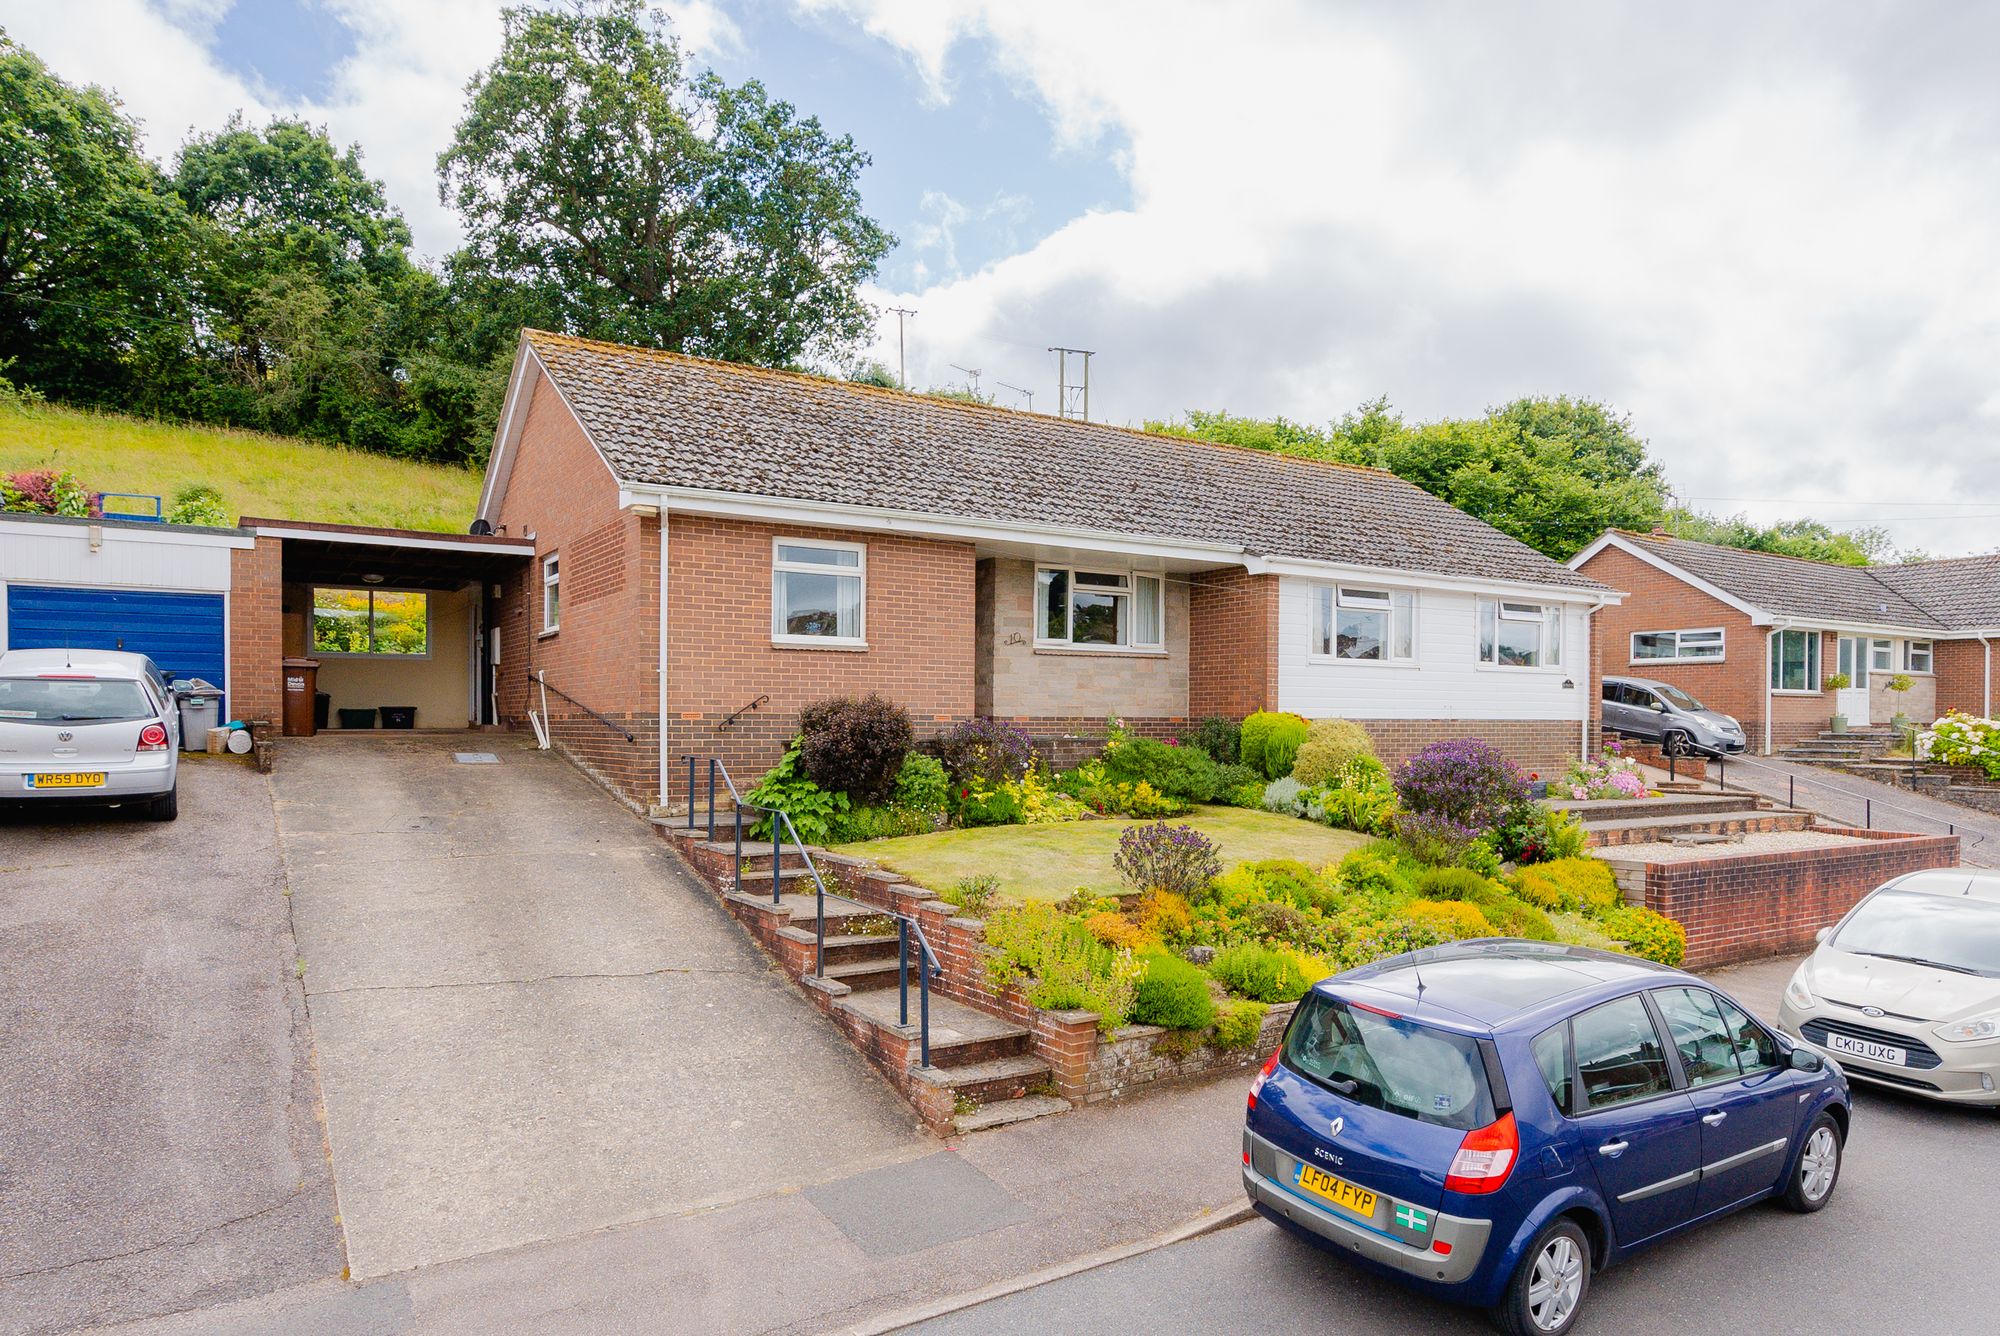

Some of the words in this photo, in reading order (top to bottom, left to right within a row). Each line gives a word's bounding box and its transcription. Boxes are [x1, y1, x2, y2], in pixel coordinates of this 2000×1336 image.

[36, 774, 71, 785] WR59
[75, 773, 101, 784] DYO
[1835, 1036, 1865, 1053] CK13
[1868, 1044, 1896, 1061] UXG
[1314, 1147, 1344, 1166] SCENIC
[1302, 1165, 1339, 1197] LF04
[1341, 1183, 1373, 1210] FYP
